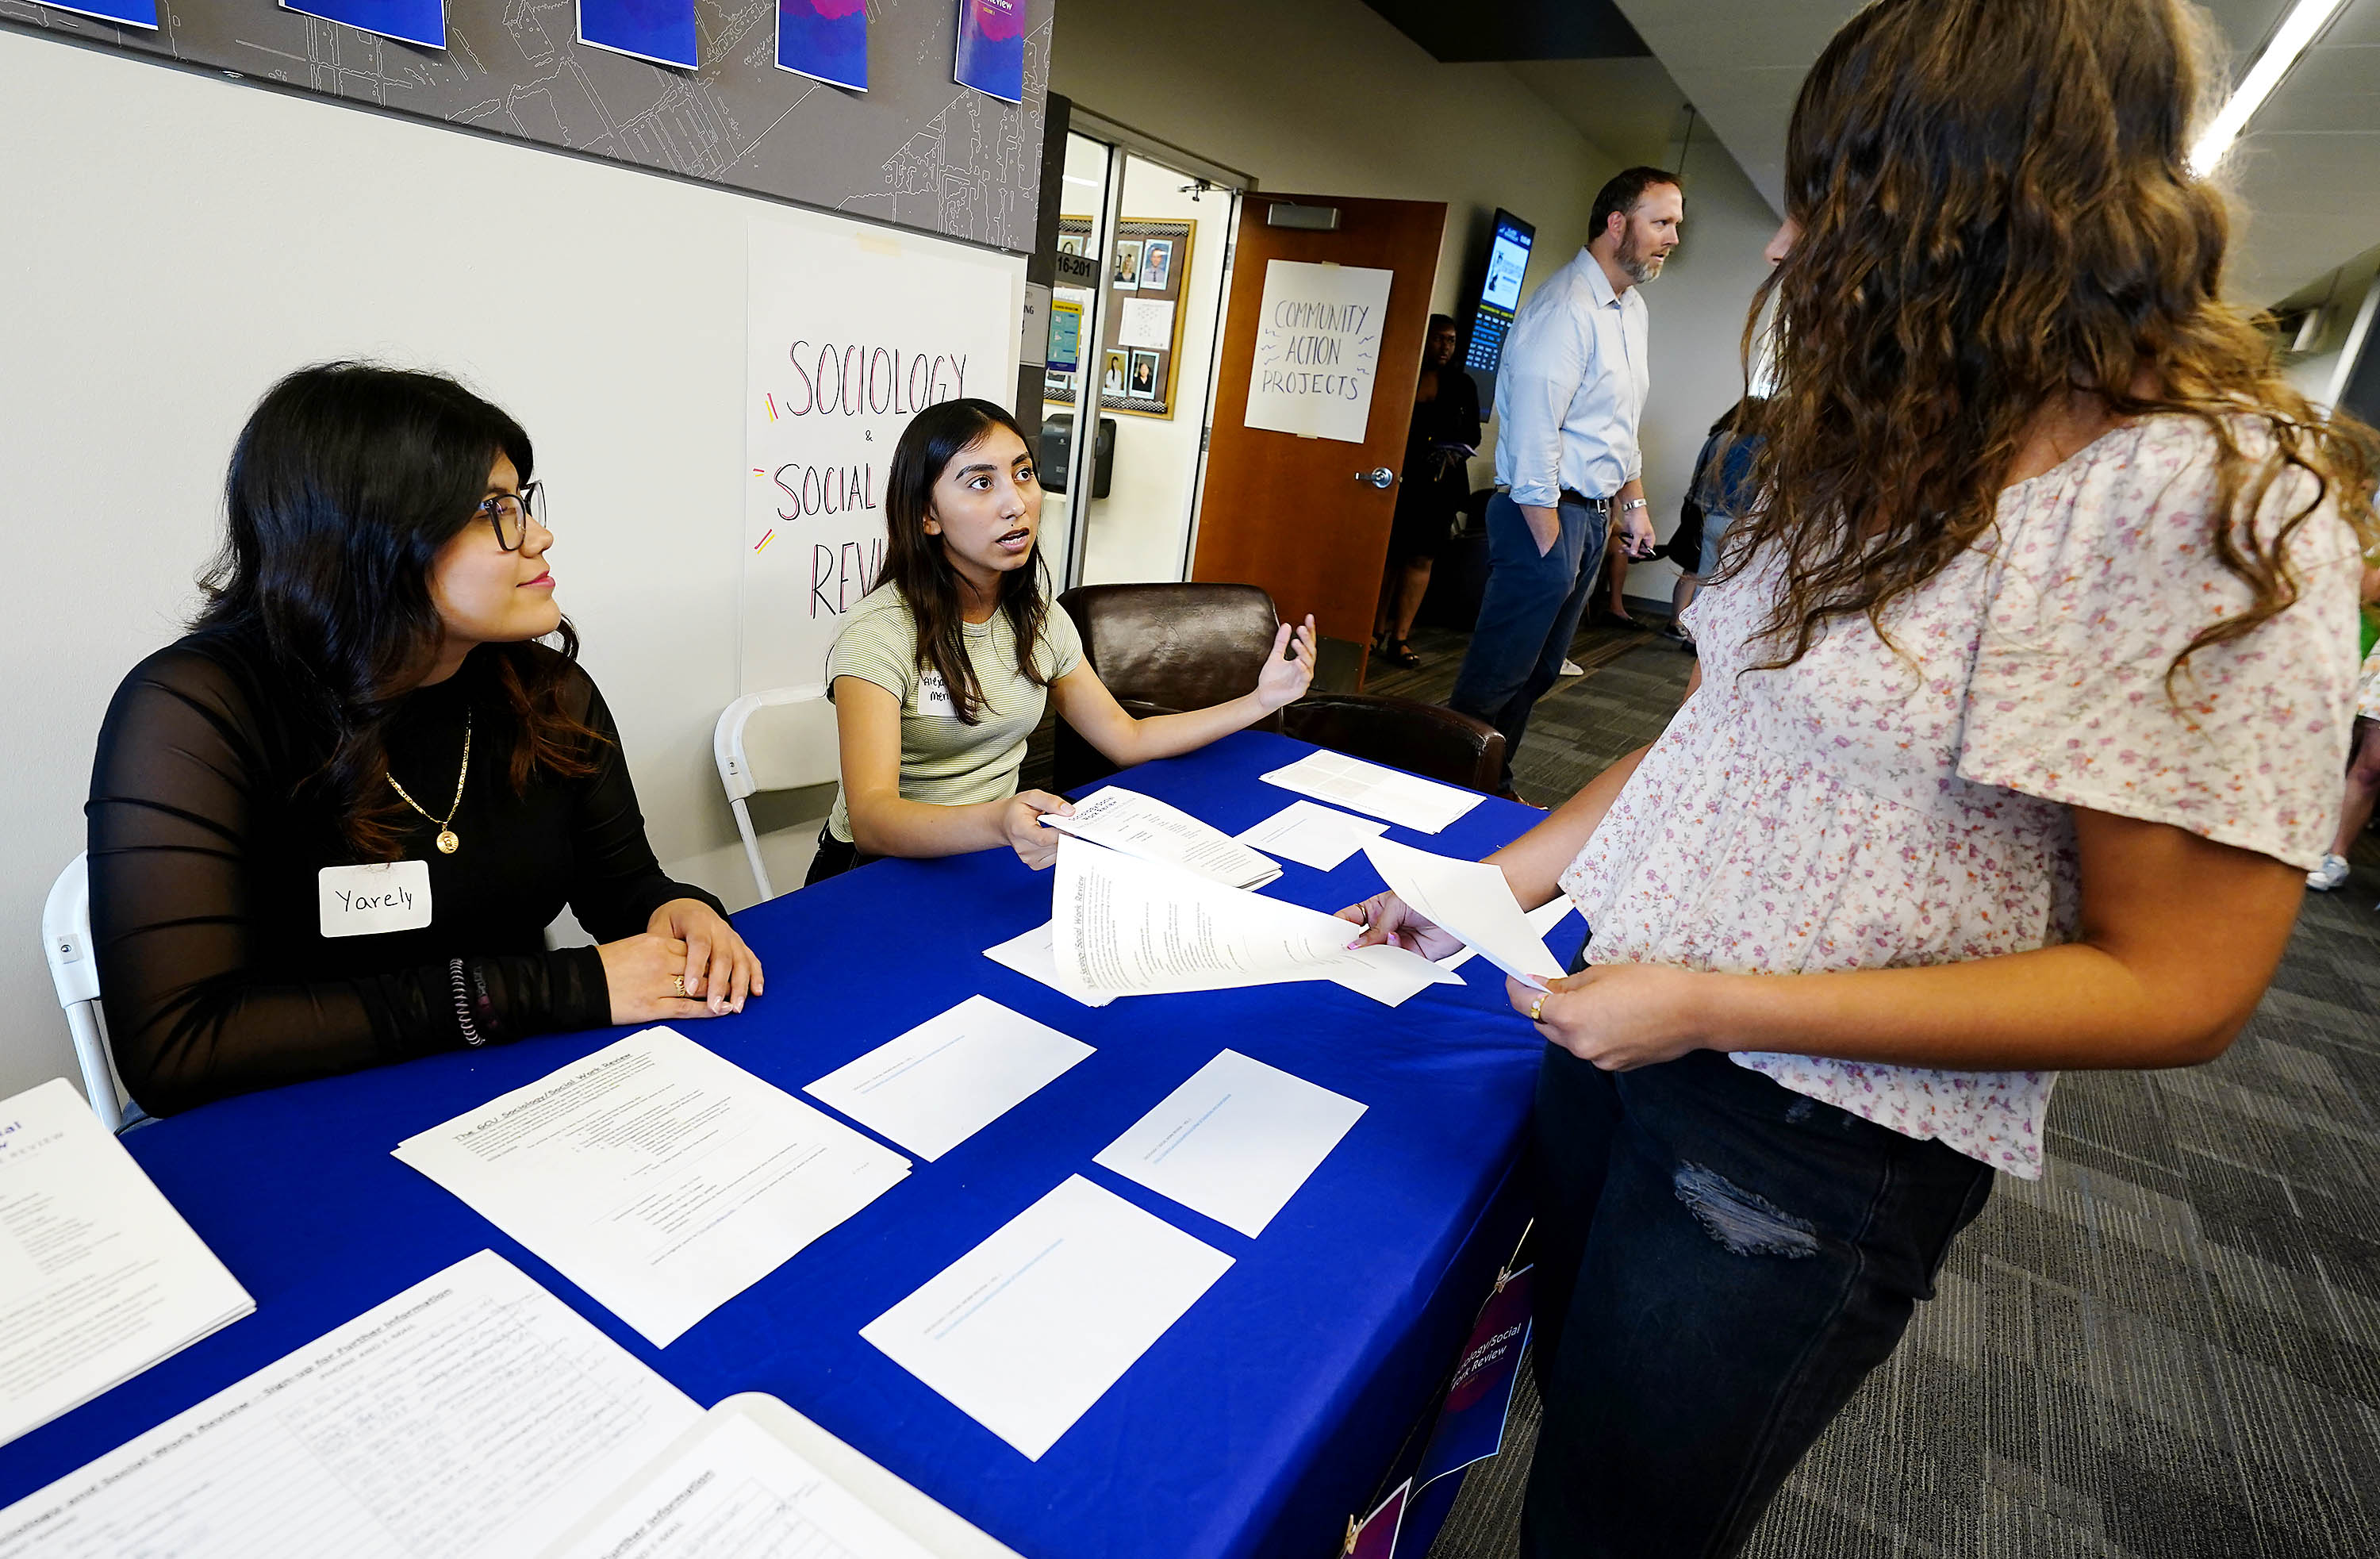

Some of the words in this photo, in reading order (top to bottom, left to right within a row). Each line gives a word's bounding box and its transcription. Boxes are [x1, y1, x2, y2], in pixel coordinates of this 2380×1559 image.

[1058, 256, 1091, 278] 16-201
[1275, 300, 1369, 335] COMMUNITY
[1285, 336, 1342, 365] ACTION
[787, 340, 965, 416] SOCIOLOGY
[1262, 370, 1358, 400] PROJECTS
[865, 430, 873, 441] &
[774, 463, 876, 520] SOCIAL
[810, 538, 882, 619] REVI
[335, 886, 413, 912] Yarely
[1075, 875, 1085, 902] Review
[601, 1053, 632, 1068] Review
[1471, 1345, 1507, 1372] Review
